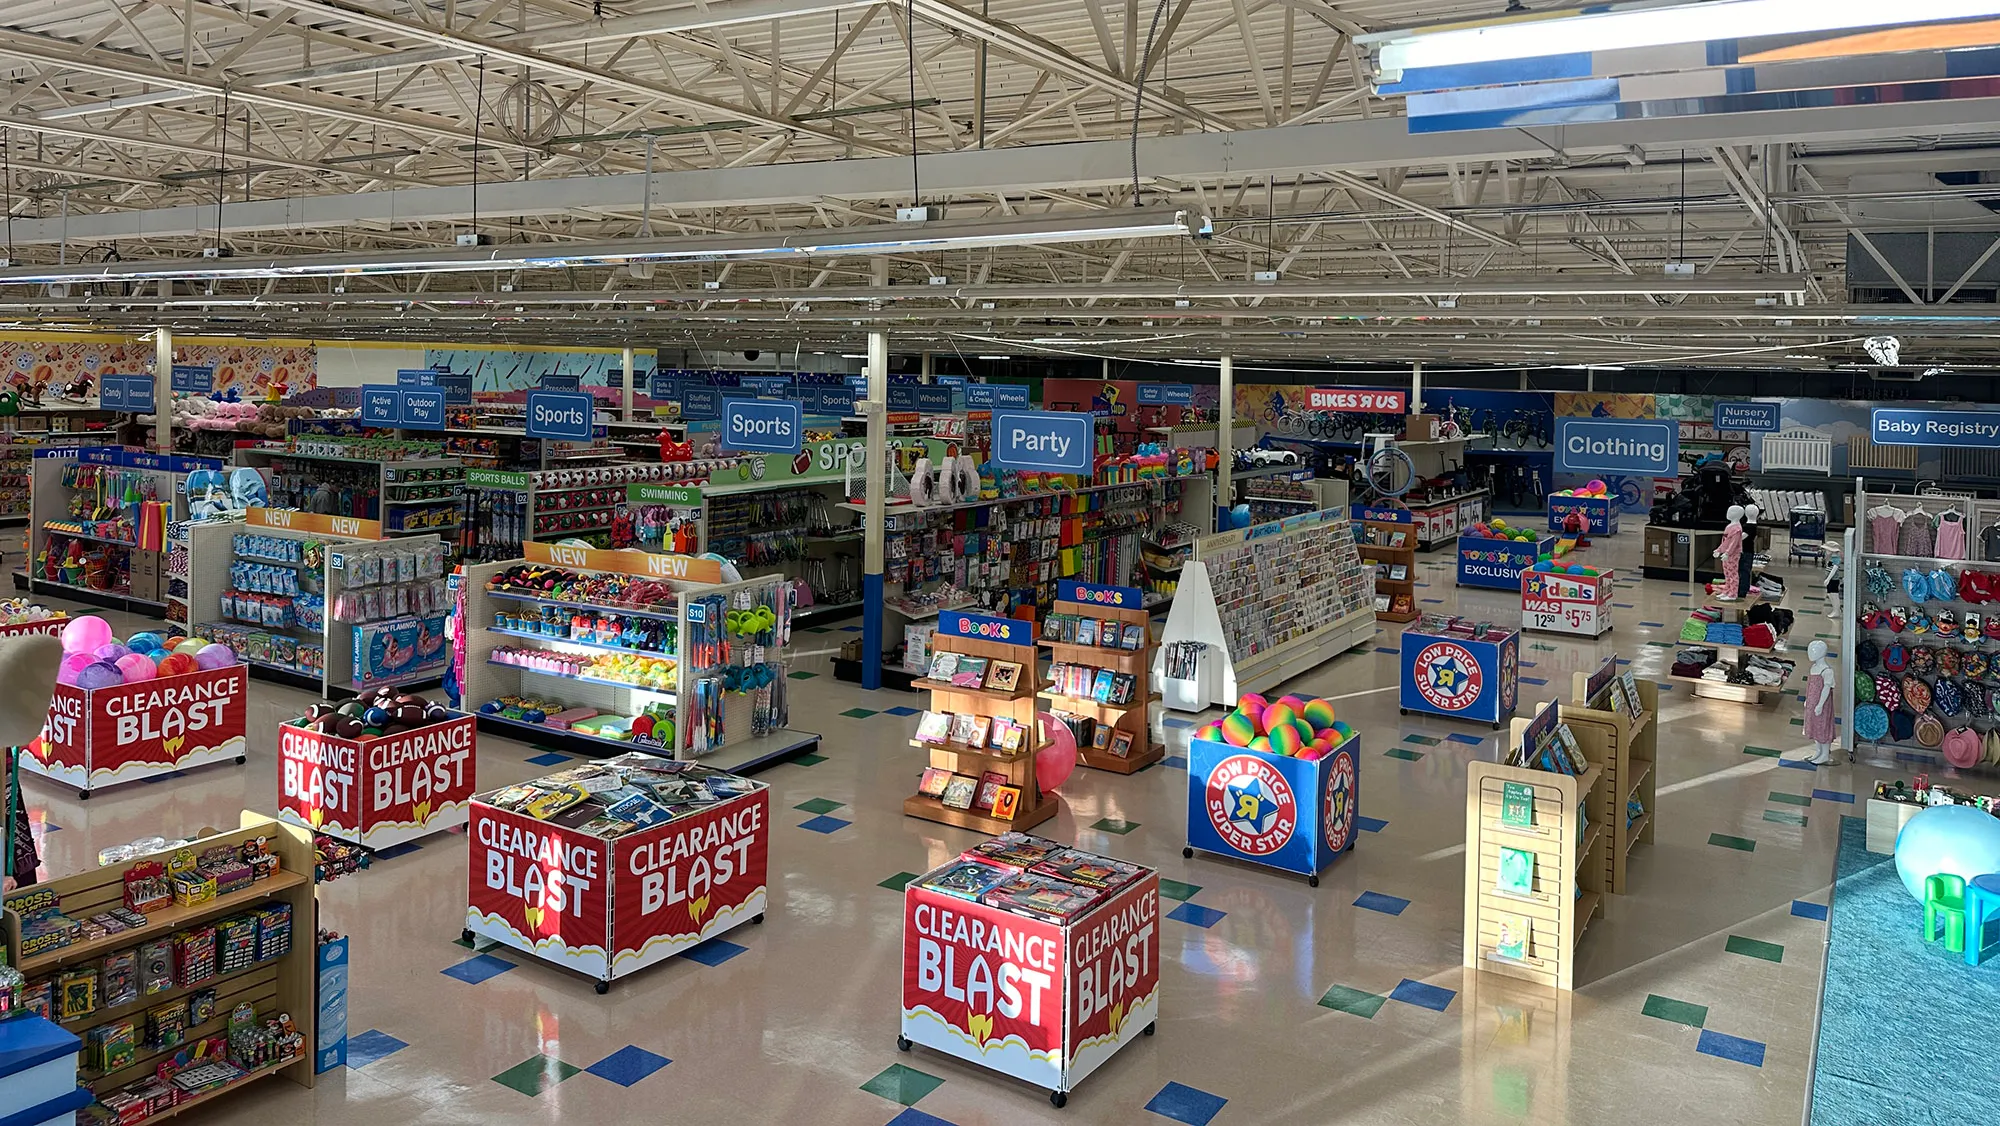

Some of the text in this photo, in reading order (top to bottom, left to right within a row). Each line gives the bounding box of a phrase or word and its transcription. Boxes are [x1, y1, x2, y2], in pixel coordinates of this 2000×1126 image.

[104, 387, 122, 400] Candy
[129, 389, 150, 398] Seasonal
[371, 395, 392, 405] Active
[688, 394, 711, 403] Stuffed
[822, 394, 850, 406] Sports
[892, 397, 912, 405] Trucks
[919, 394, 947, 404] Wheels
[974, 396, 993, 404] Create
[1000, 393, 1025, 402] Wheels
[1167, 390, 1189, 398] Wheels
[1311, 392, 1357, 408] BIKES
[1375, 395, 1399, 409] US
[407, 397, 436, 408] Outdoor
[687, 402, 712, 411] Animals
[374, 406, 388, 418] Play
[413, 408, 430, 419] Play
[535, 404, 584, 427] Sports
[1725, 407, 1768, 419] Nursery
[732, 413, 791, 438] Sports
[1721, 416, 1771, 427] Furniture
[1878, 420, 2000, 438] Baby Registry
[1012, 429, 1071, 458] Party
[1568, 436, 1665, 462] Clothing
[386, 471, 394, 479] S6
[470, 472, 525, 486] SPORTS BALLS
[518, 494, 527, 502] D2
[640, 488, 688, 501] SWIMMING
[265, 511, 291, 527] NEW
[332, 518, 360, 535] NEW
[1206, 533, 1236, 549] ANNIVERSARY
[1679, 535, 1689, 543] G1
[332, 557, 343, 566] S8
[549, 547, 587, 567] NEW
[1462, 550, 1496, 563] TOYS
[1514, 554, 1534, 566] US
[648, 556, 688, 577] NEW
[1465, 565, 1522, 579] EXCLUSIV
[1549, 581, 1592, 600] deals
[689, 608, 704, 618] S10
[1525, 600, 1560, 613] WAS
[377, 620, 417, 634] PINK FLAMINGO
[1418, 646, 1442, 669] LOW
[1445, 645, 1478, 676] PRICE
[106, 677, 239, 717] CLEARANCE
[1417, 674, 1480, 708] SUPER STAR
[117, 697, 231, 747] BLAST
[282, 732, 355, 773] CLEARANCE
[369, 724, 472, 770] CLEARANCE
[284, 759, 353, 812] BLAST
[374, 749, 470, 811] BLAST
[1211, 760, 1291, 805] LOW PRICE
[1210, 799, 1292, 852] SUPER STAR
[629, 803, 762, 876] CLEARANCE
[478, 817, 598, 879] CLEARANCE
[487, 849, 589, 918] BLAST
[641, 835, 754, 916] BLAST
[5, 891, 53, 911] GROSS
[28, 900, 52, 911] PUTTY
[1075, 889, 1156, 968] CLEARANCE
[22, 933, 59, 950] GROSS
[914, 904, 1056, 972] CLEARANCE
[918, 937, 1052, 1026] BLAST
[1078, 922, 1153, 1027] BLAST
